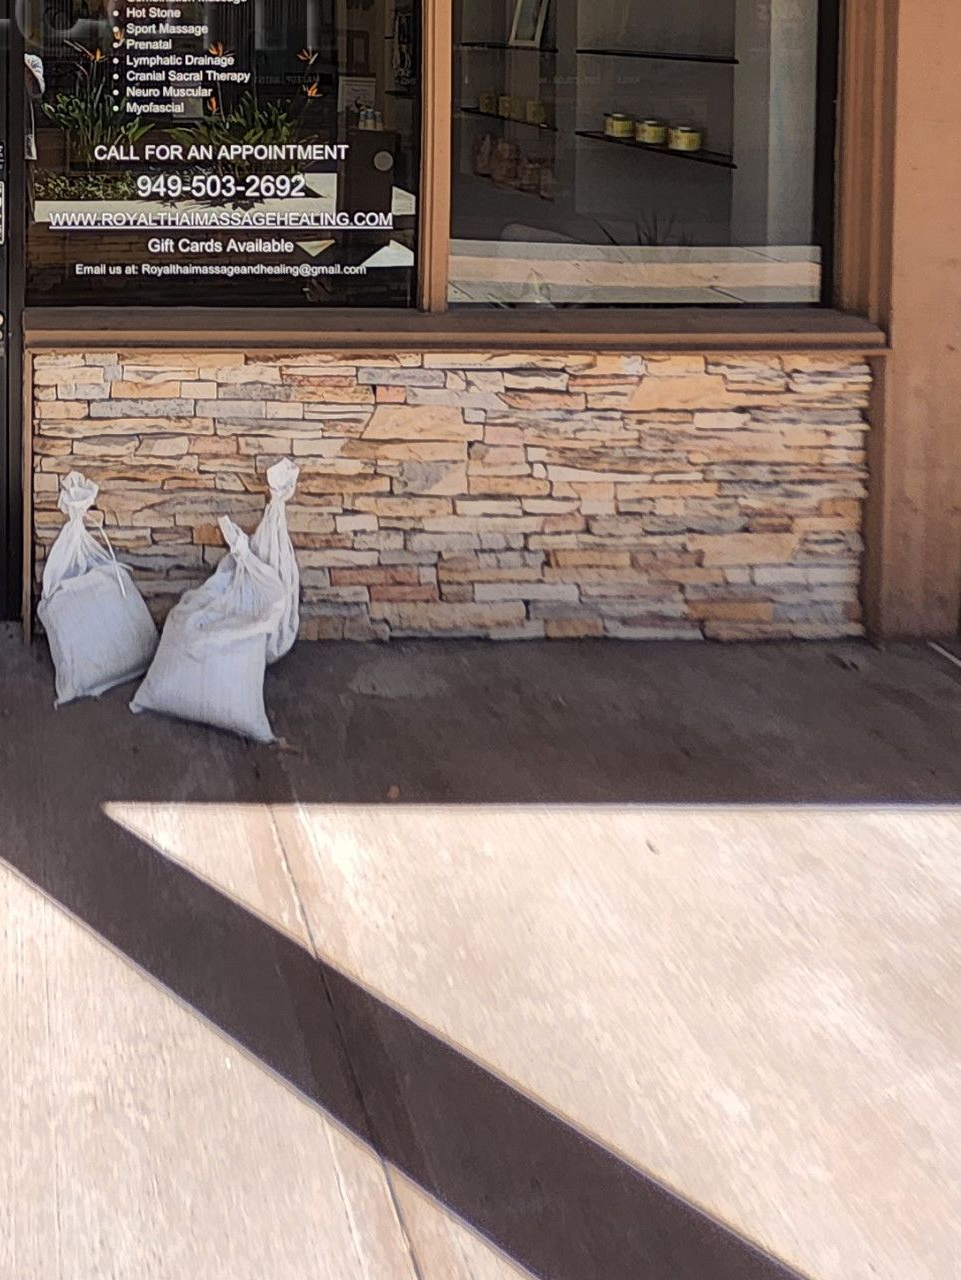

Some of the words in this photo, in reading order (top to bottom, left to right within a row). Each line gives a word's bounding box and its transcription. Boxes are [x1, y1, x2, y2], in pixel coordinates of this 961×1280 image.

[126, 7, 146, 18] Hot
[148, 7, 181, 18] Stone
[126, 23, 157, 37] Sport
[158, 23, 209, 37] Massage
[126, 39, 172, 50] Prenatal
[126, 55, 182, 68] Lymphatic
[185, 55, 234, 68] Drainage
[126, 71, 165, 81] Cranial
[168, 71, 203, 81] Sacral
[205, 71, 251, 84] Therapy
[126, 87, 160, 97] Neuro
[162, 87, 213, 97] Muscular
[126, 102, 184, 115] Myofascial
[94, 145, 139, 160] CALL
[145, 145, 183, 160] FOR
[187, 145, 214, 160] AN
[217, 145, 349, 160] APPOINTMENT
[136, 174, 306, 197] 949-503-2692
[49, 212, 393, 228] WWW.ROYALTHAIMASSAGEHEALING.COM
[148, 239, 174, 253] Gift
[178, 239, 223, 253] Cards
[226, 239, 294, 253] Available
[75, 263, 105, 275] Email
[109, 266, 122, 275] us
[125, 264, 138, 275] at:
[141, 263, 367, 277] Royalthaimassageandhealing@gmail.com
